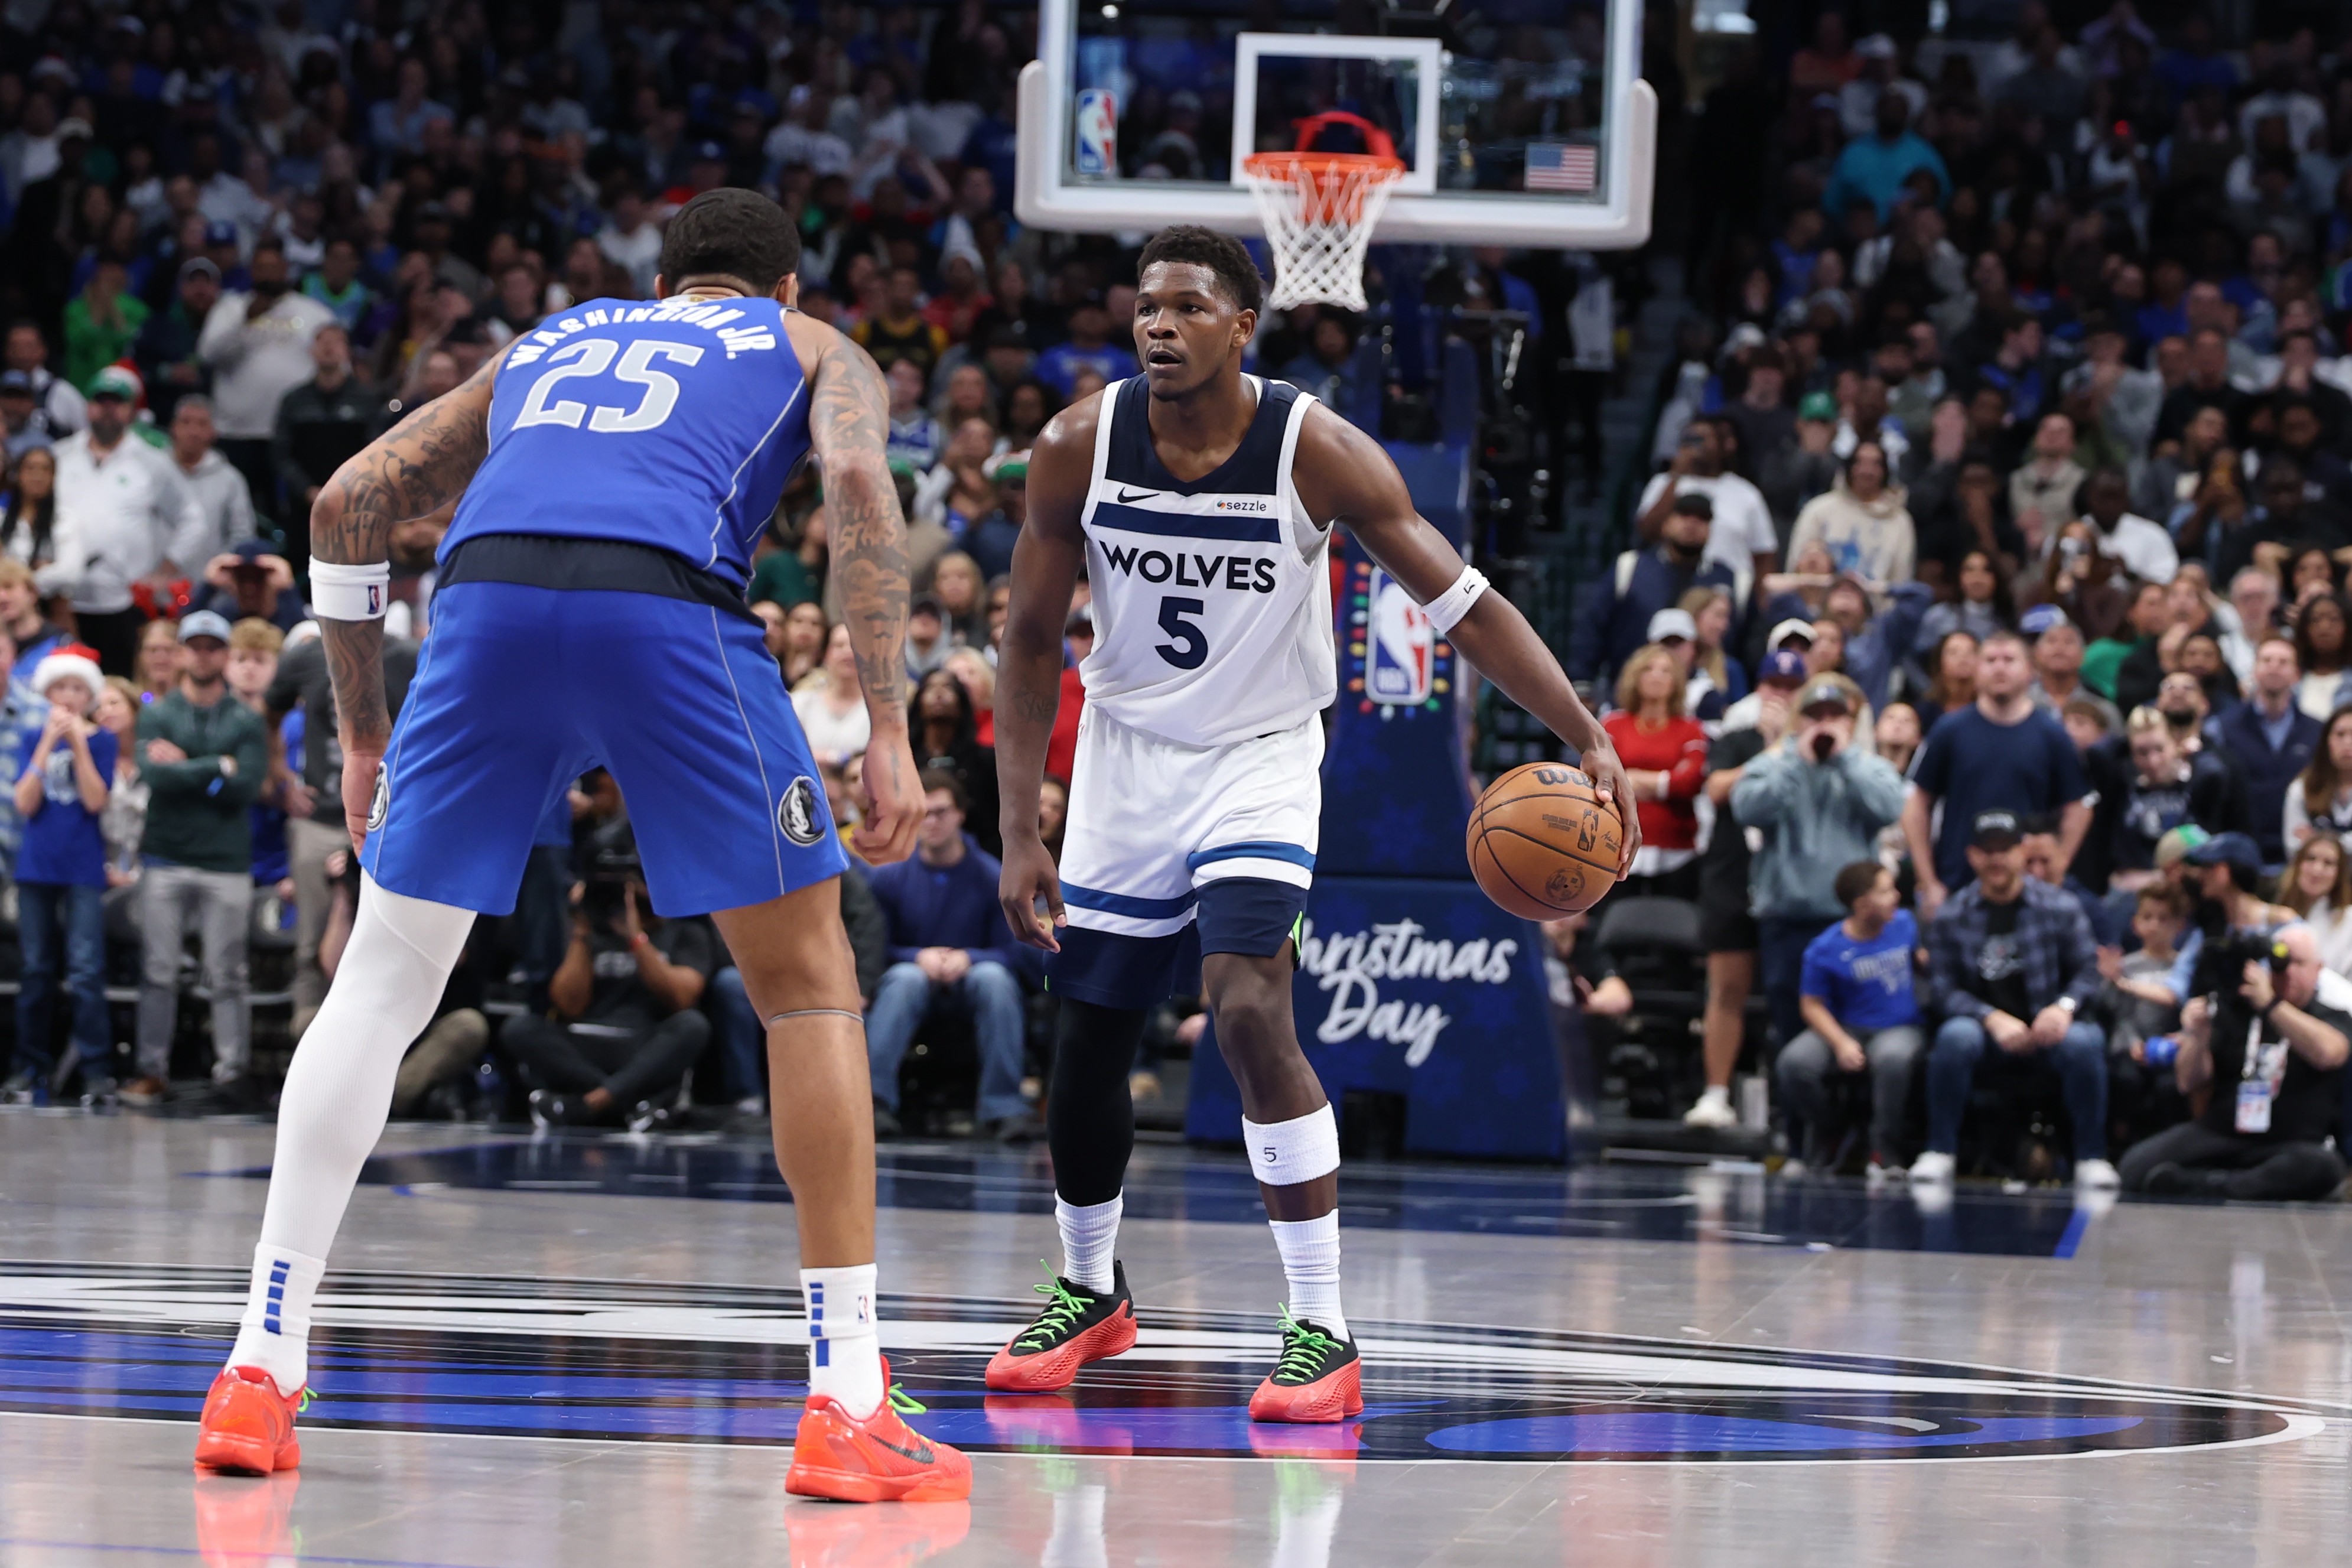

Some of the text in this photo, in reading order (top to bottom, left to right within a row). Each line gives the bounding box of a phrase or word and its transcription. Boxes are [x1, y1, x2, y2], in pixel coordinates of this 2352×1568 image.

[506, 300, 777, 370] WASHINGTON JR.
[511, 339, 705, 433] 25
[1227, 500, 1267, 512] sezzle
[1099, 540, 1276, 594] WOLVES
[1154, 596, 1209, 670] 5
[1300, 918, 1518, 984] hristmas
[1316, 969, 1452, 1068] Day
[1264, 1147, 1277, 1162] 5
